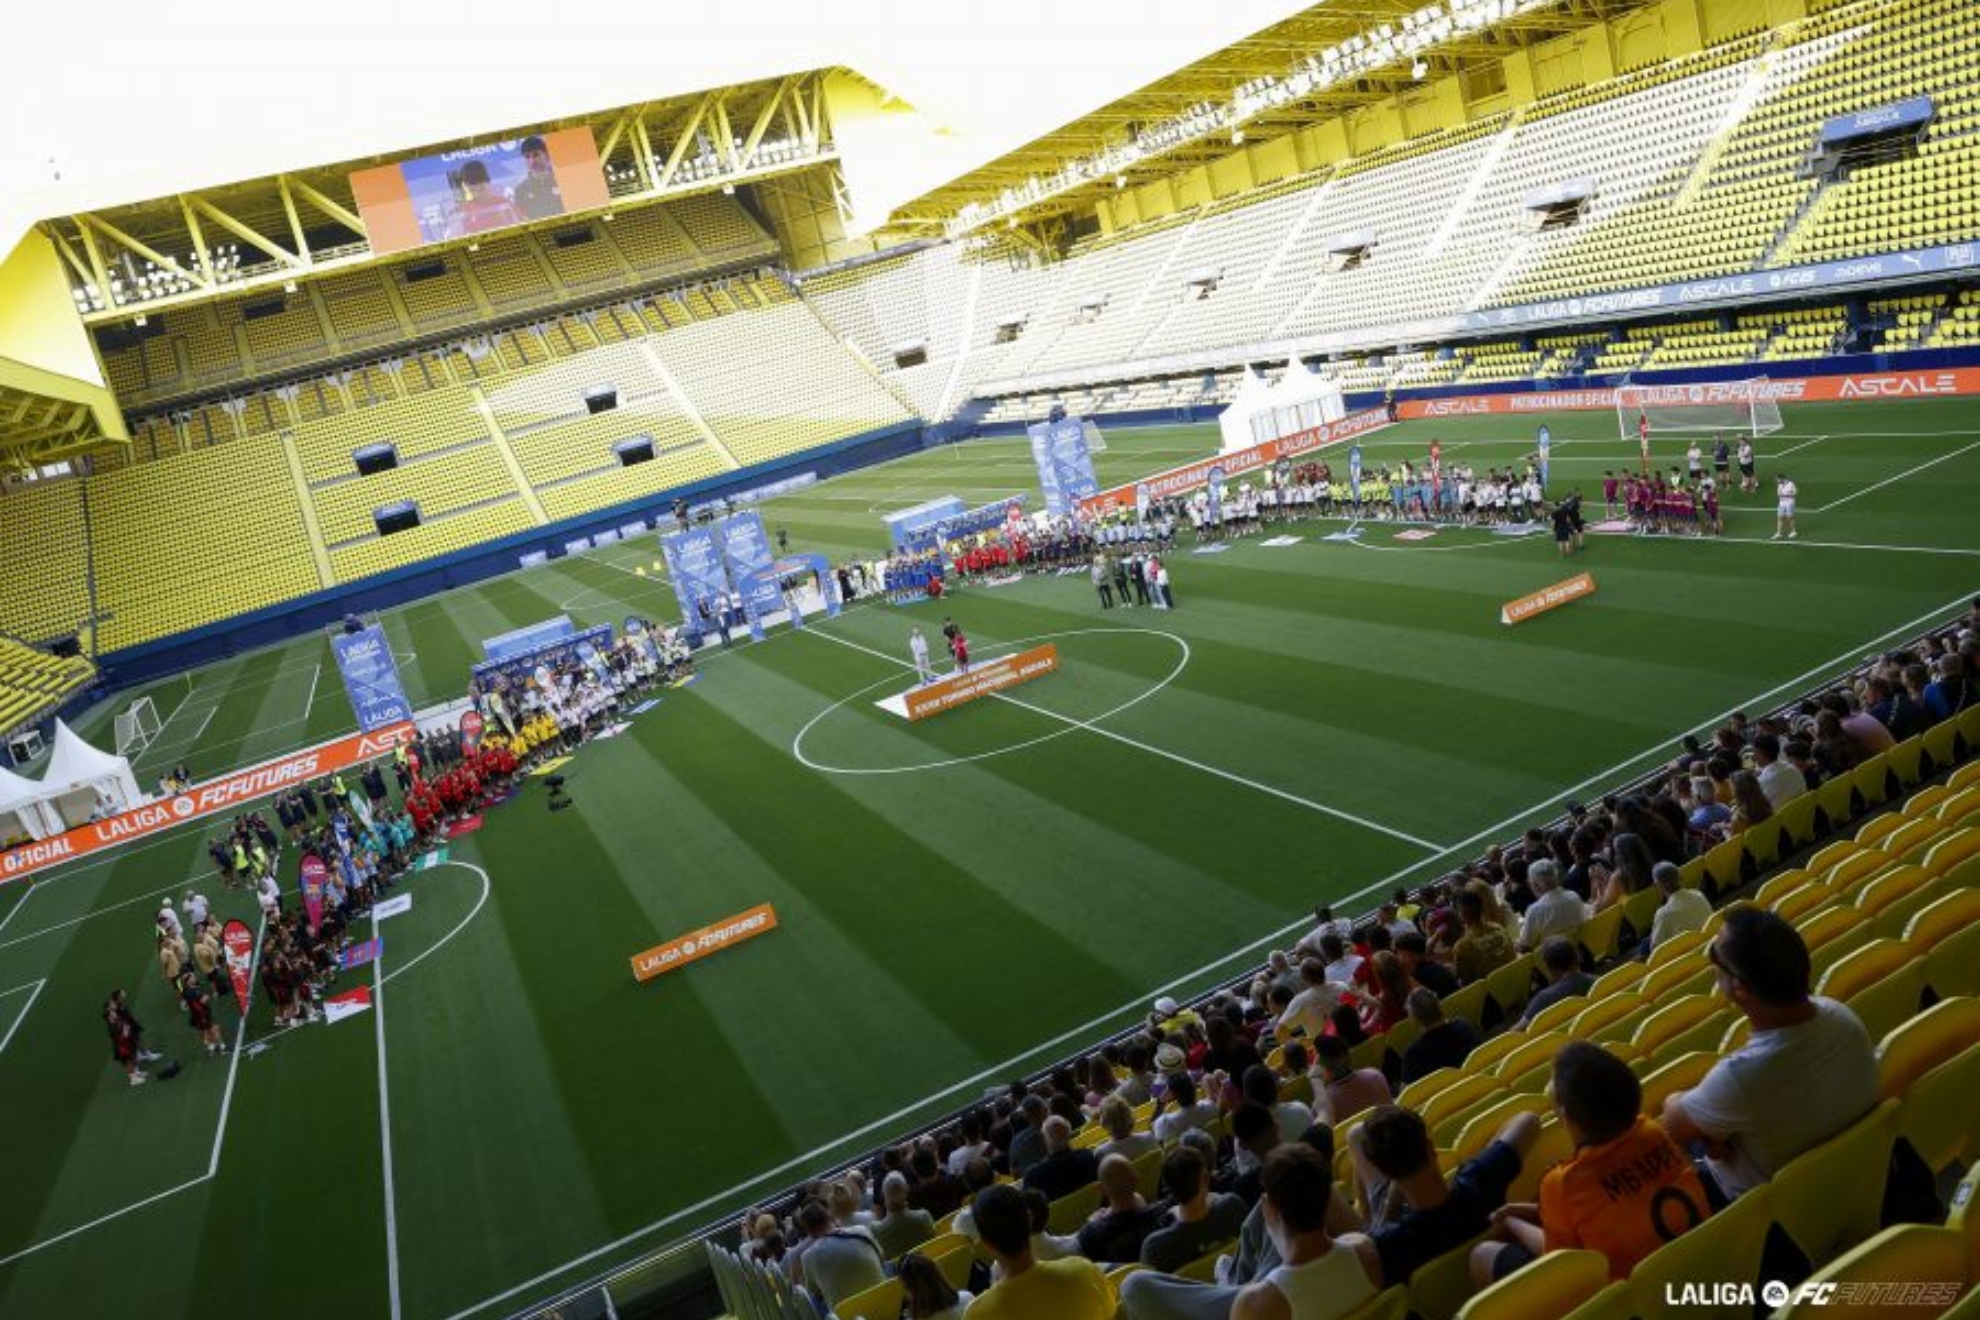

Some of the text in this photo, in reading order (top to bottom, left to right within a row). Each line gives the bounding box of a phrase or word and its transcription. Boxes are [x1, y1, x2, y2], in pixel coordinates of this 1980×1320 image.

[1681, 280, 1754, 300] ASCALE
[1527, 301, 1568, 320] LALIGA
[1839, 374, 1957, 396] ASCALE
[1424, 400, 1490, 415] ASCALE
[1585, 389, 1620, 406] OFICIA
[96, 806, 169, 843] LALIGA
[640, 948, 682, 971] LALIGA
